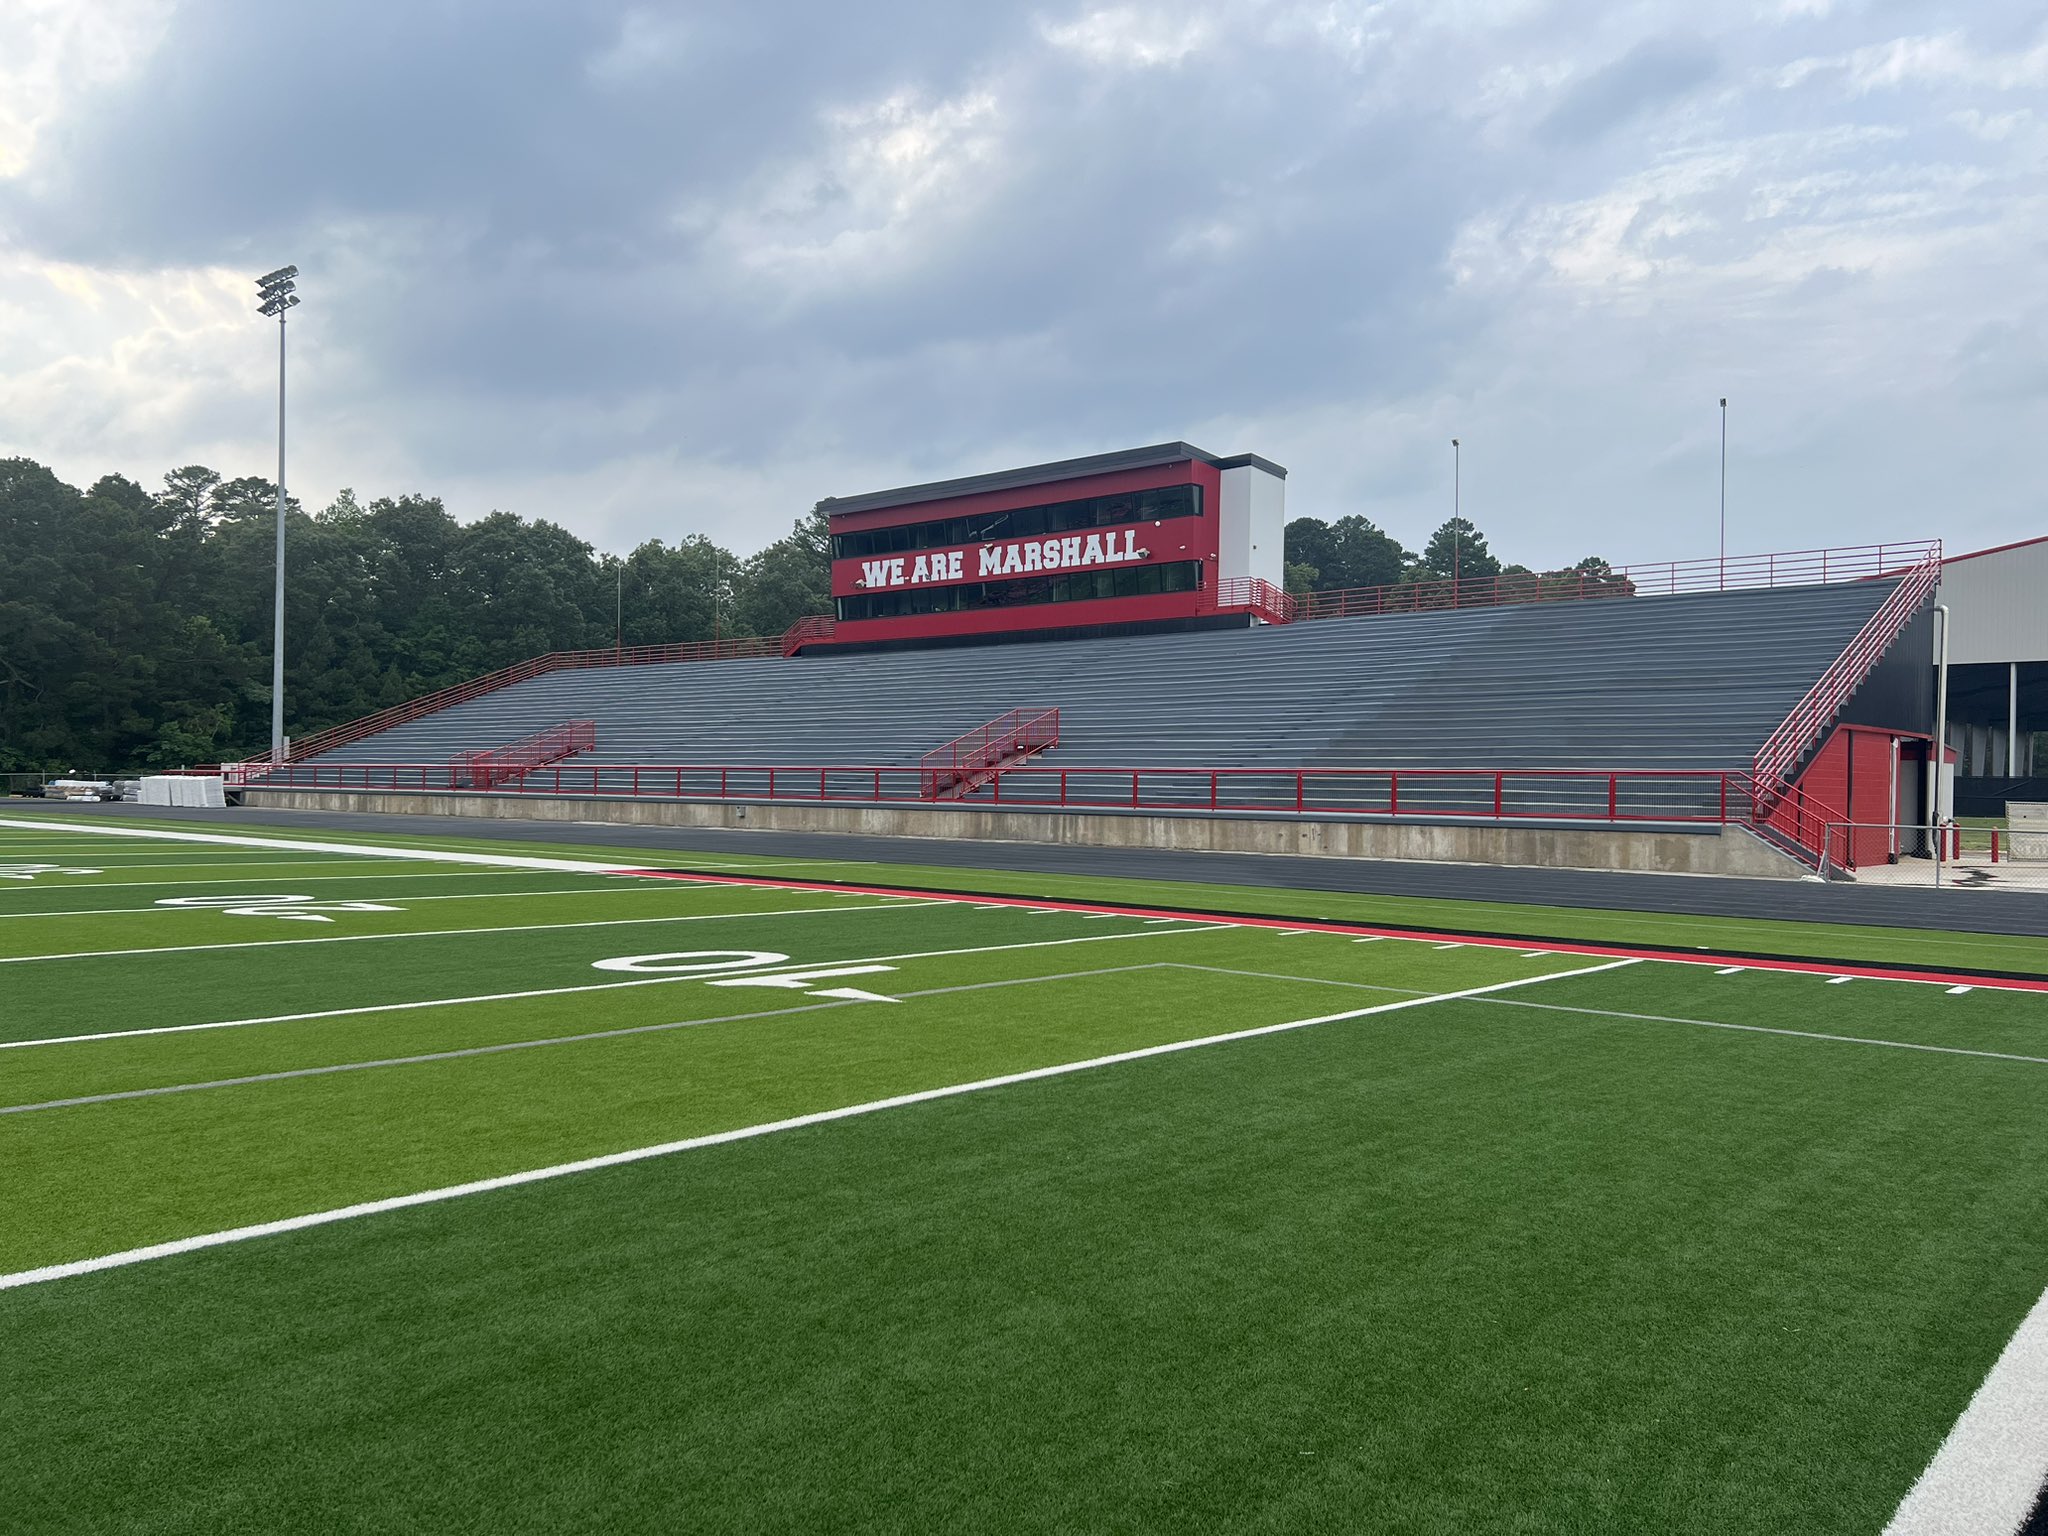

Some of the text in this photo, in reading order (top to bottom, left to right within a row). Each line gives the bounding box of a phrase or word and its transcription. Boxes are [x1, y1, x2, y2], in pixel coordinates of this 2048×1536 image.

[862, 529, 1143, 588] WE ARE MARSHALL
